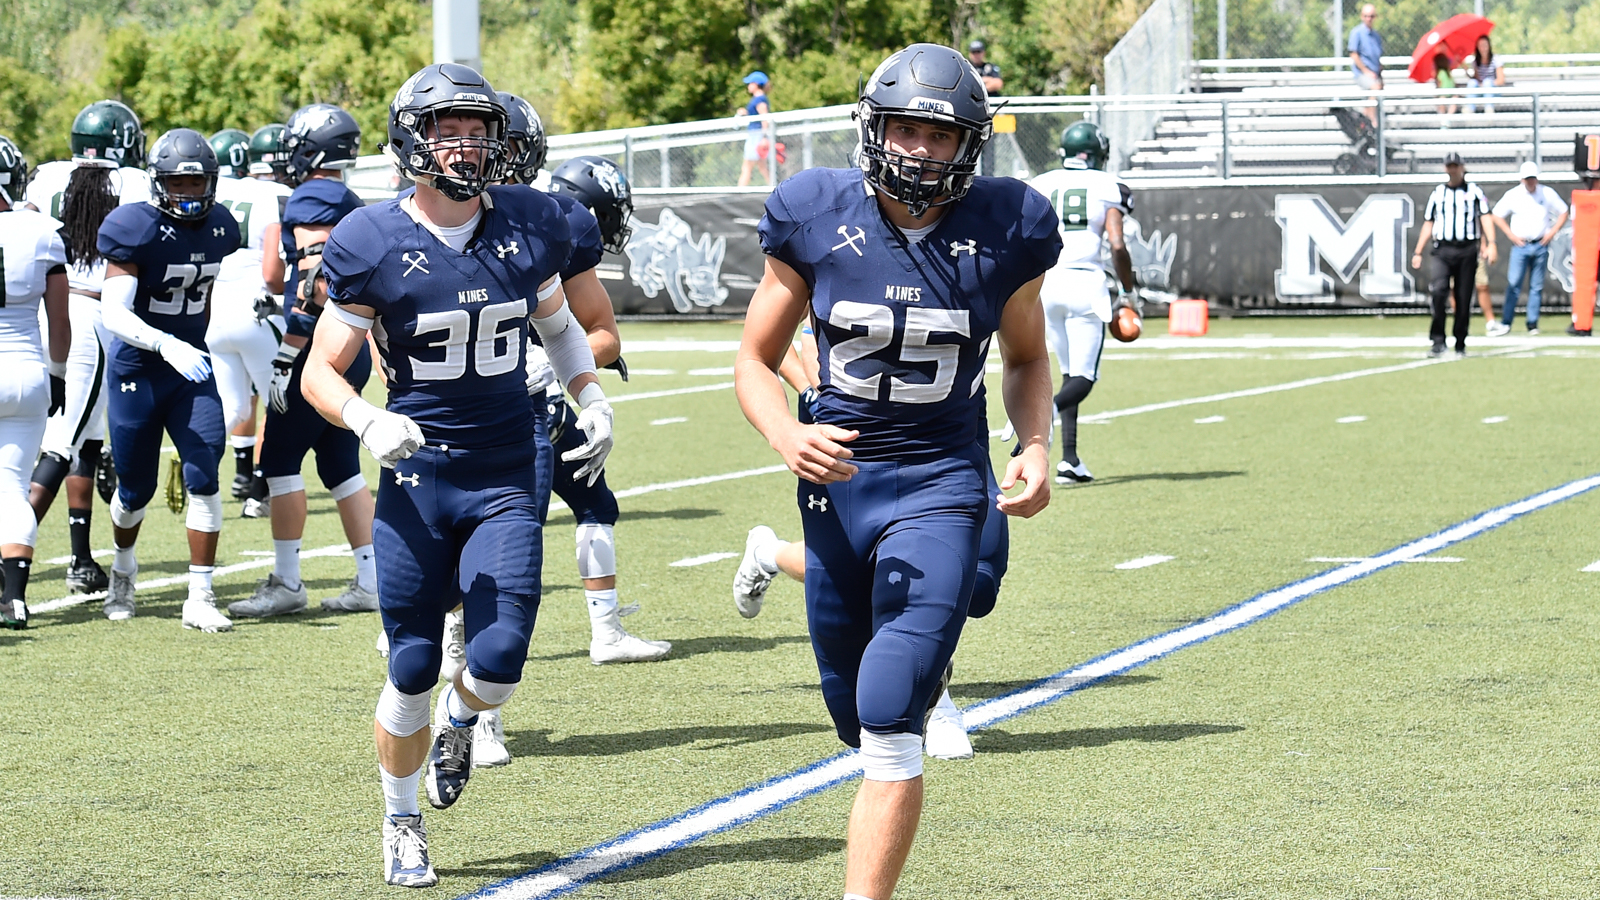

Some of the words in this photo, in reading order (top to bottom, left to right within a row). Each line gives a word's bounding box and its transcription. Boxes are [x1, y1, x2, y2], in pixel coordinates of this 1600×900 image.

[917, 100, 945, 113] MINES
[1274, 193, 1415, 303] M
[148, 262, 221, 316] 33
[457, 288, 489, 304] MINES
[884, 284, 922, 302] MINES
[407, 297, 528, 381] 36
[827, 300, 971, 404] 25
